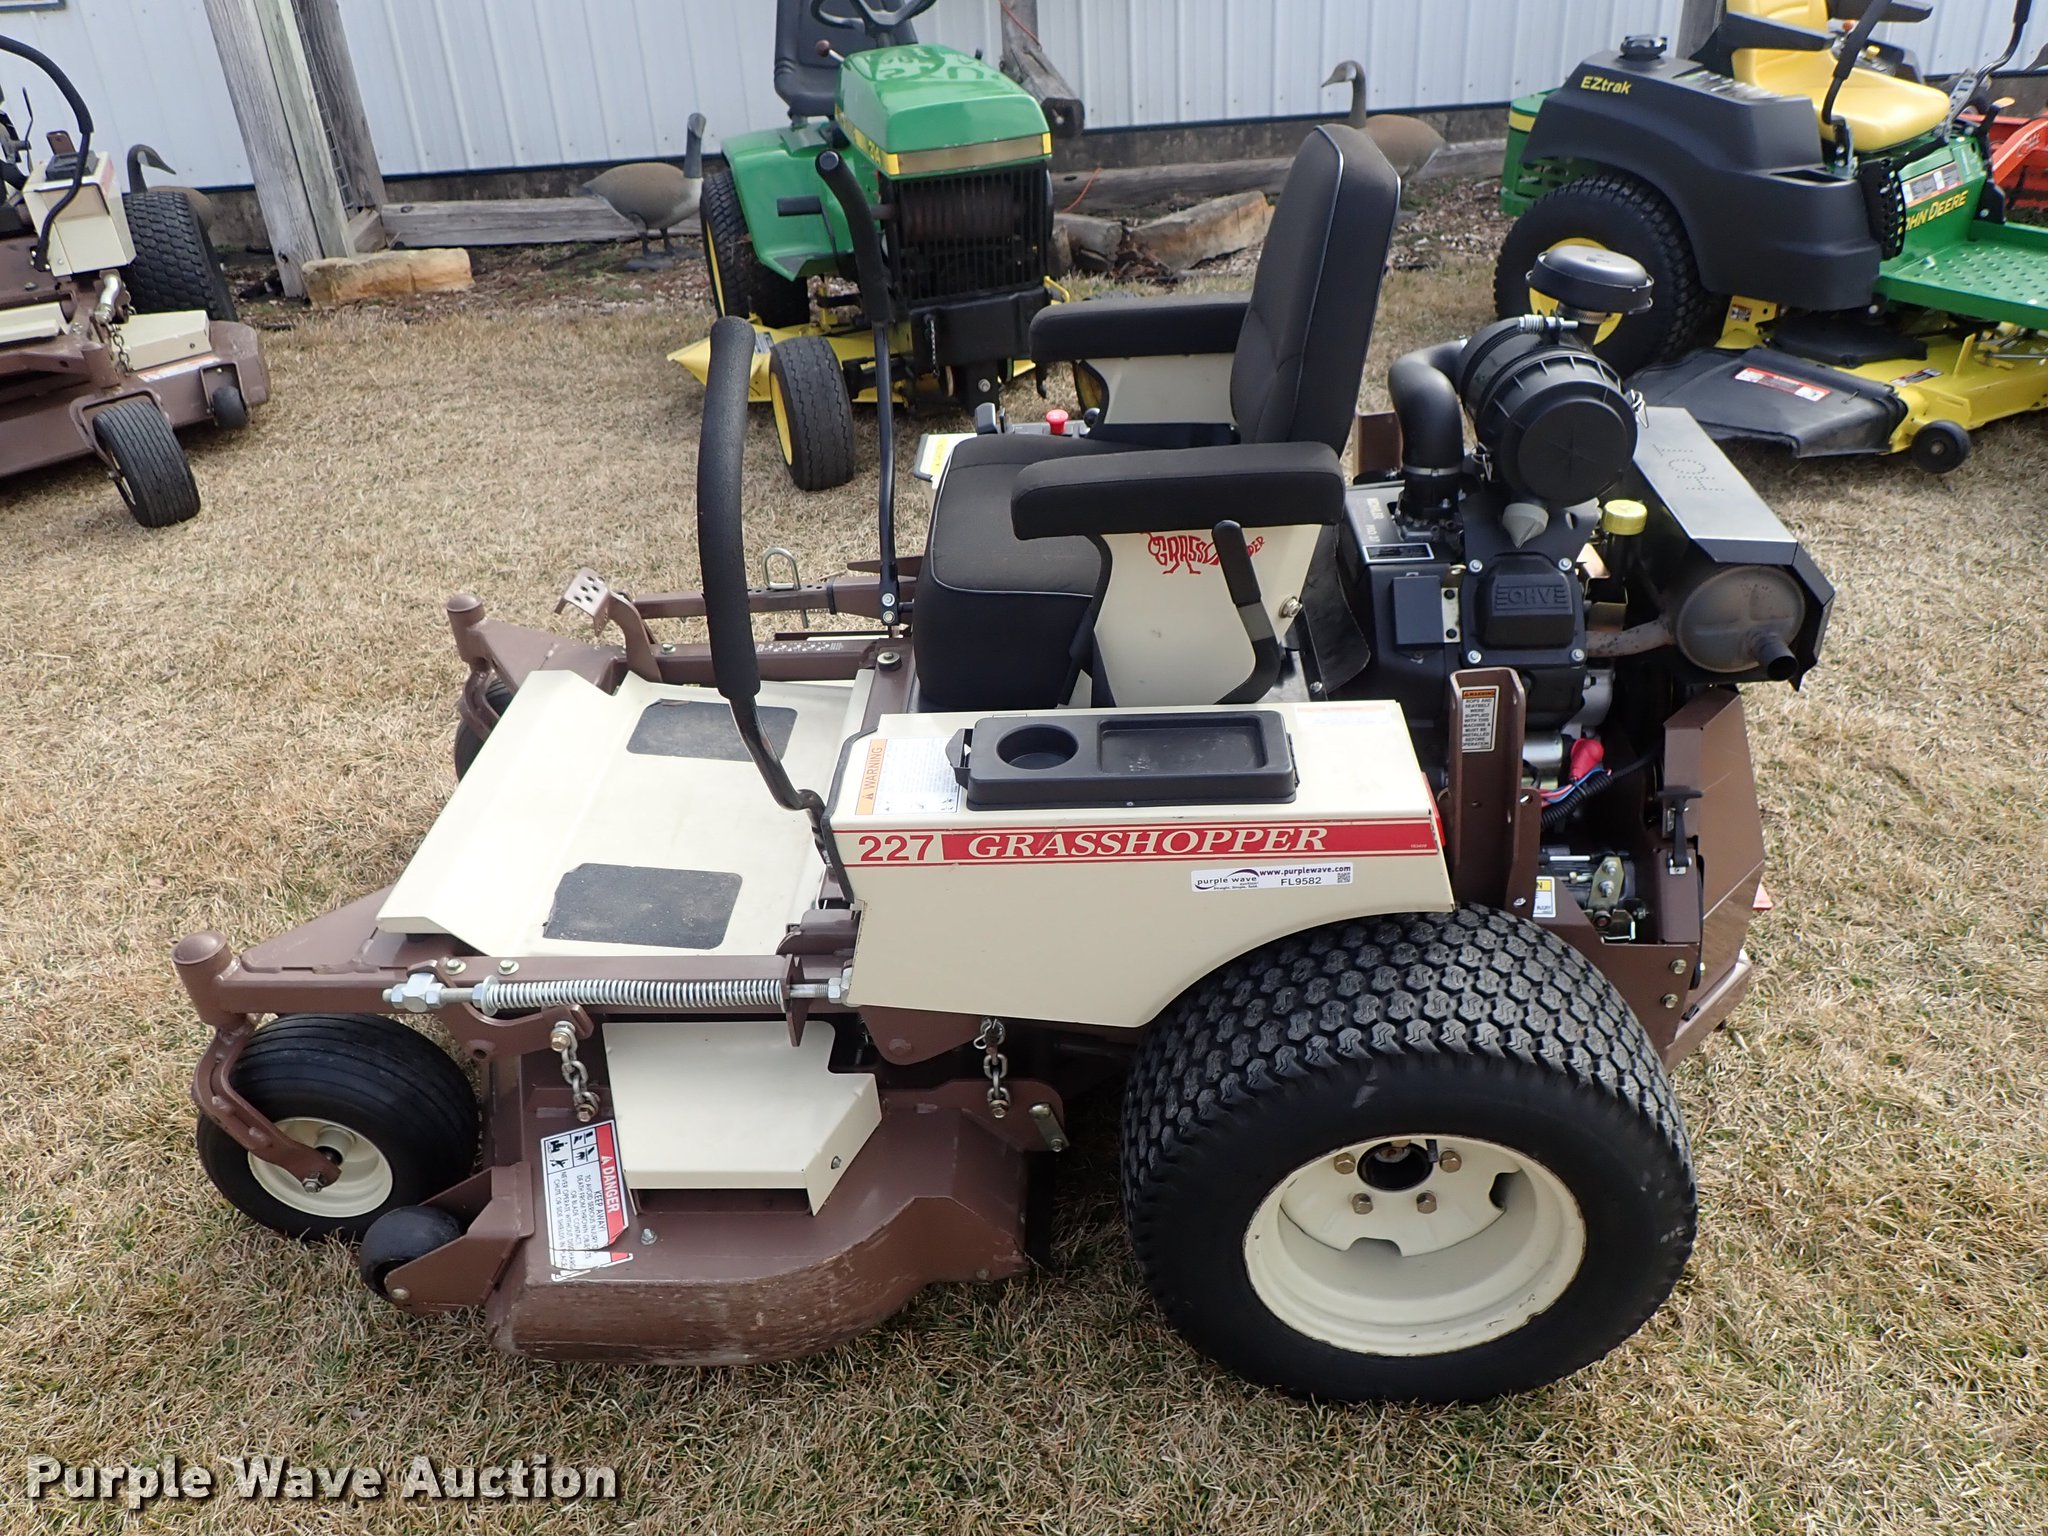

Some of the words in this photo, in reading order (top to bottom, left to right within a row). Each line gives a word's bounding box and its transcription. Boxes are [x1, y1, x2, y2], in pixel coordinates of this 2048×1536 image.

[1581, 76, 1631, 94] EZtrak
[1928, 190, 1969, 221] DEERE
[863, 747, 883, 790] WARNING
[858, 834, 935, 862] 227
[967, 827, 1328, 859] GRASSHOPPER
[1259, 866, 1351, 877] www.purplewave.com
[1197, 877, 1229, 885] purple
[1280, 877, 1322, 886] FL9582
[593, 1190, 603, 1207] KEEP
[602, 1166, 620, 1213] DANGER
